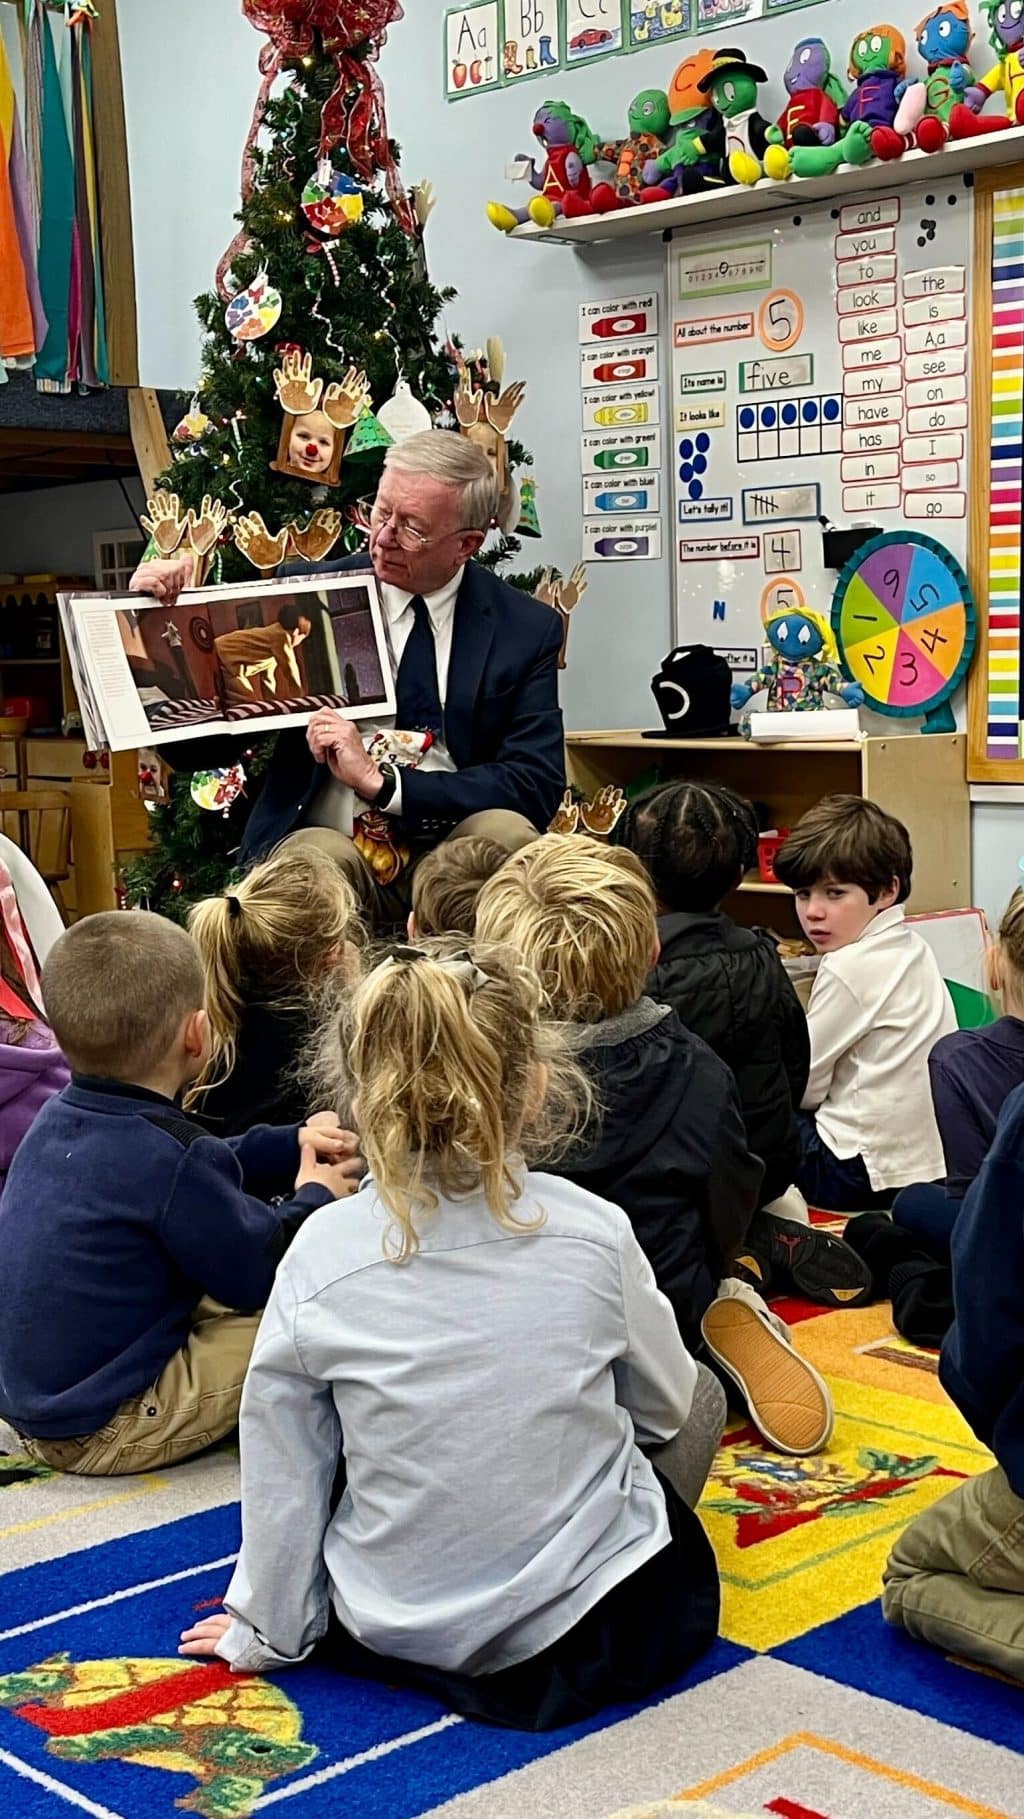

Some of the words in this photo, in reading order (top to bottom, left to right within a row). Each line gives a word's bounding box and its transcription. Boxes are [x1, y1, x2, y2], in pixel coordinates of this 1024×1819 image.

[457, 15, 487, 54] Aa
[674, 64, 697, 92] C
[859, 86, 881, 114] F
[927, 78, 949, 110] G
[541, 166, 565, 194] A
[858, 206, 880, 224] and
[852, 238, 876, 254] you
[858, 265, 873, 279] to
[922, 277, 945, 291] the
[853, 290, 879, 308] look
[929, 305, 938, 318] is
[769, 299, 791, 342] 5
[858, 320, 877, 335] like
[677, 329, 686, 338] All
[688, 326, 707, 336] about
[710, 323, 721, 333] the
[723, 321, 749, 331] number
[861, 350, 881, 362] me
[923, 361, 946, 374] see
[684, 377, 695, 388] Its
[697, 378, 715, 386] name
[747, 363, 792, 389] five
[862, 378, 883, 391] my
[927, 388, 943, 400] on
[680, 412, 687, 421] It
[690, 411, 706, 421] looks
[709, 409, 719, 418] like
[858, 407, 888, 420] have
[929, 412, 945, 427] do
[602, 437, 617, 445] color
[620, 435, 633, 443] with
[859, 434, 882, 448] has
[929, 440, 936, 455] I
[865, 463, 874, 476] in
[604, 480, 621, 488] color
[624, 478, 637, 486] with
[866, 492, 875, 505] it
[684, 505, 701, 514] Let's
[704, 504, 718, 515] tally
[927, 502, 942, 517] go
[683, 544, 694, 552] The
[696, 544, 718, 552] number
[720, 541, 742, 552] before
[771, 536, 790, 568] 4
[909, 583, 940, 612] 5
[713, 600, 726, 622] N
[920, 628, 948, 653] 4
[863, 645, 885, 675] 2
[900, 652, 918, 686] 3
